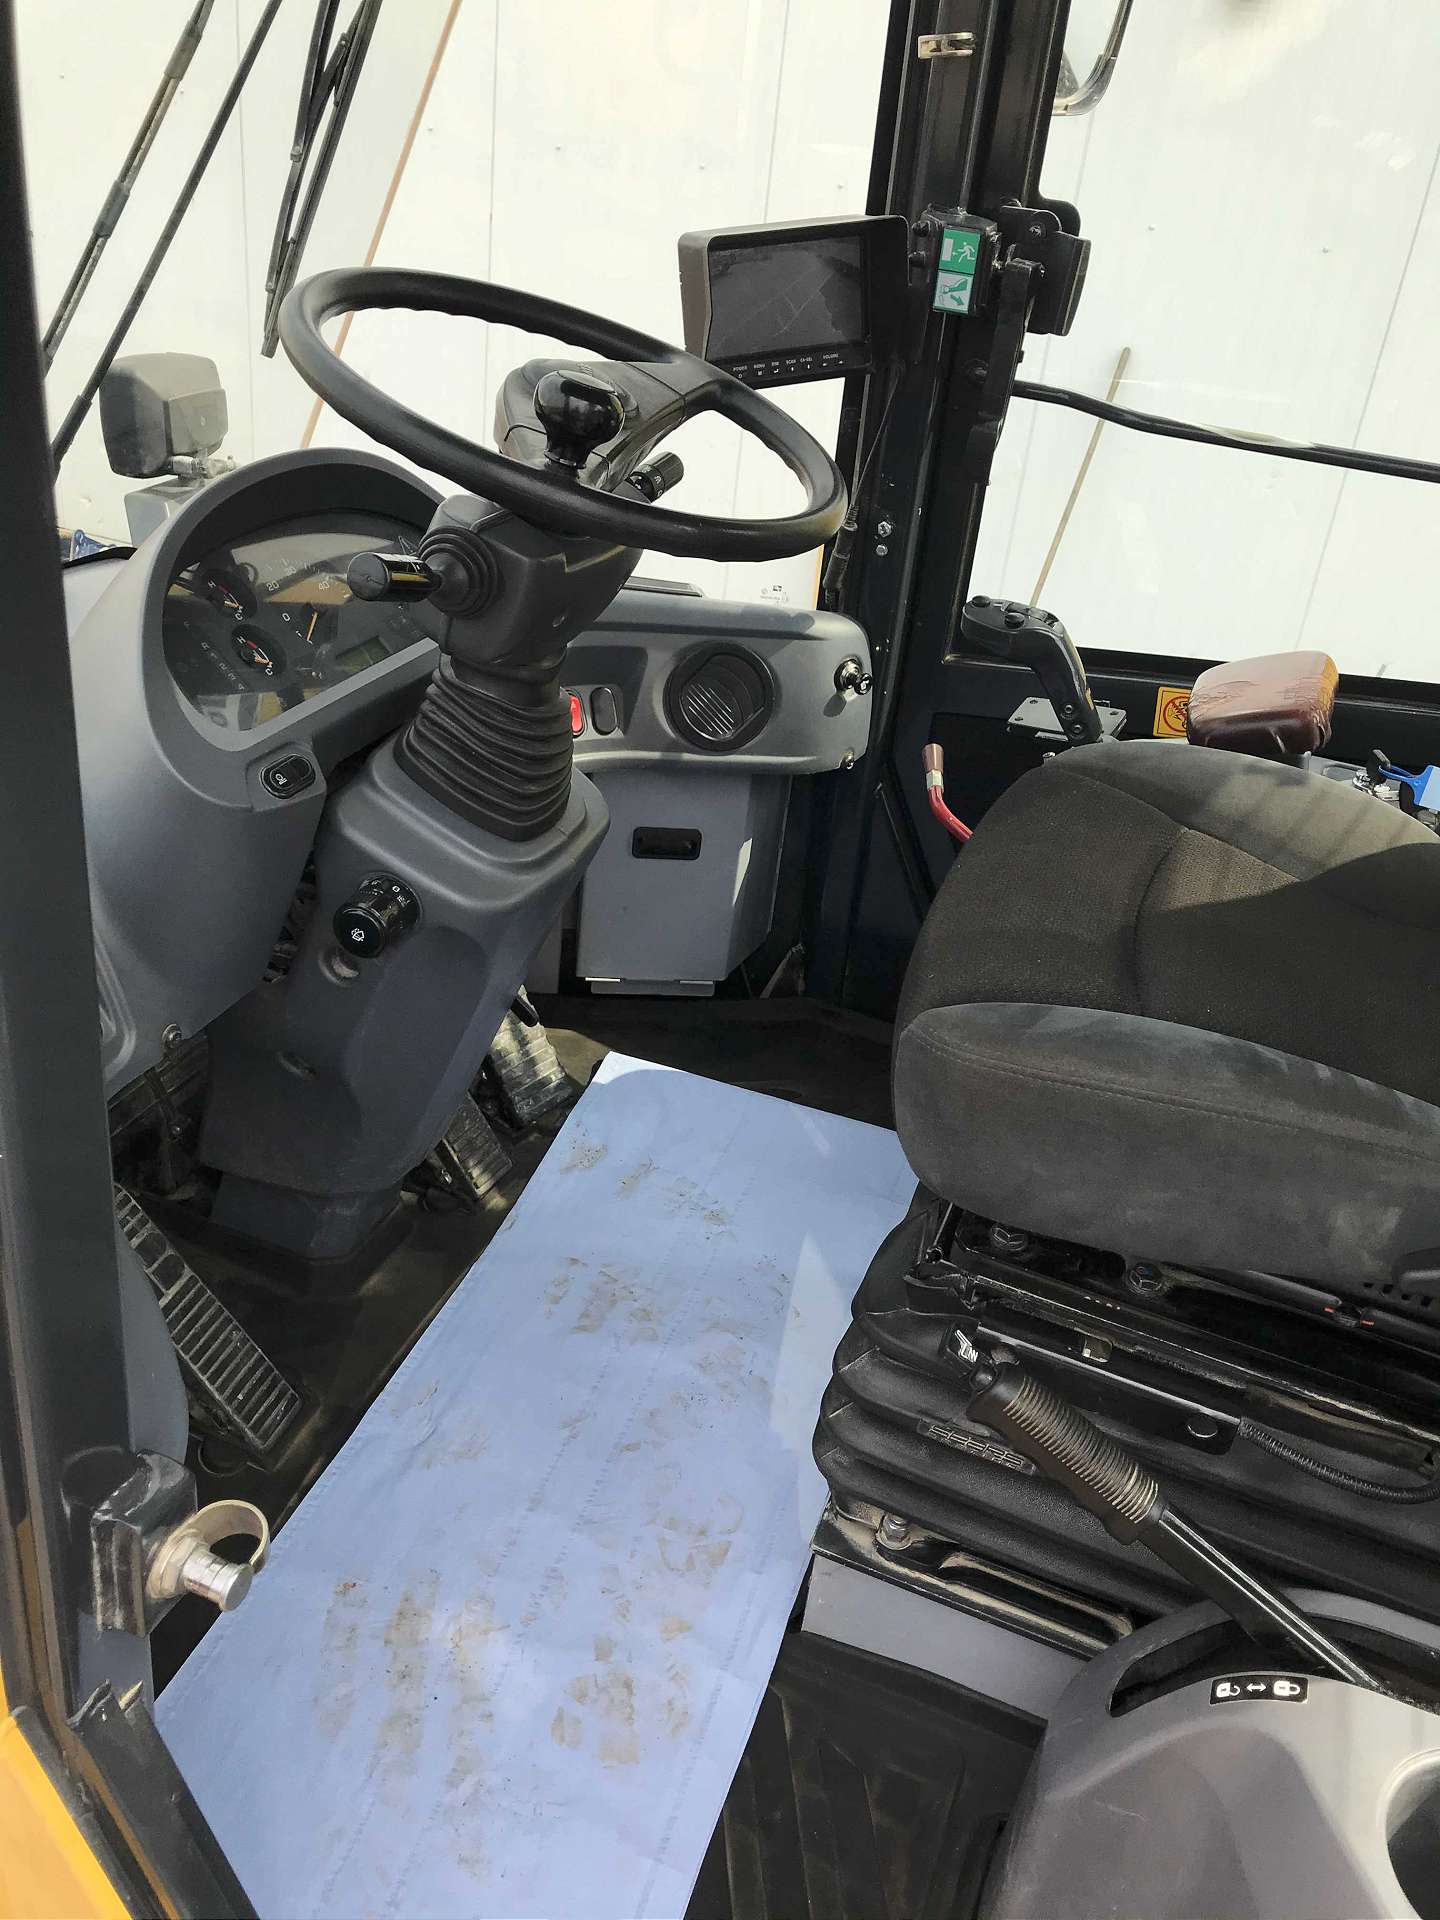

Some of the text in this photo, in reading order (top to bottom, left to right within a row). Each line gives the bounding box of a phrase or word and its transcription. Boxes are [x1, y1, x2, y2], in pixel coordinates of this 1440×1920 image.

[266, 580, 280, 592] 20
[318, 580, 330, 591] 40
[281, 612, 291, 622] 0
